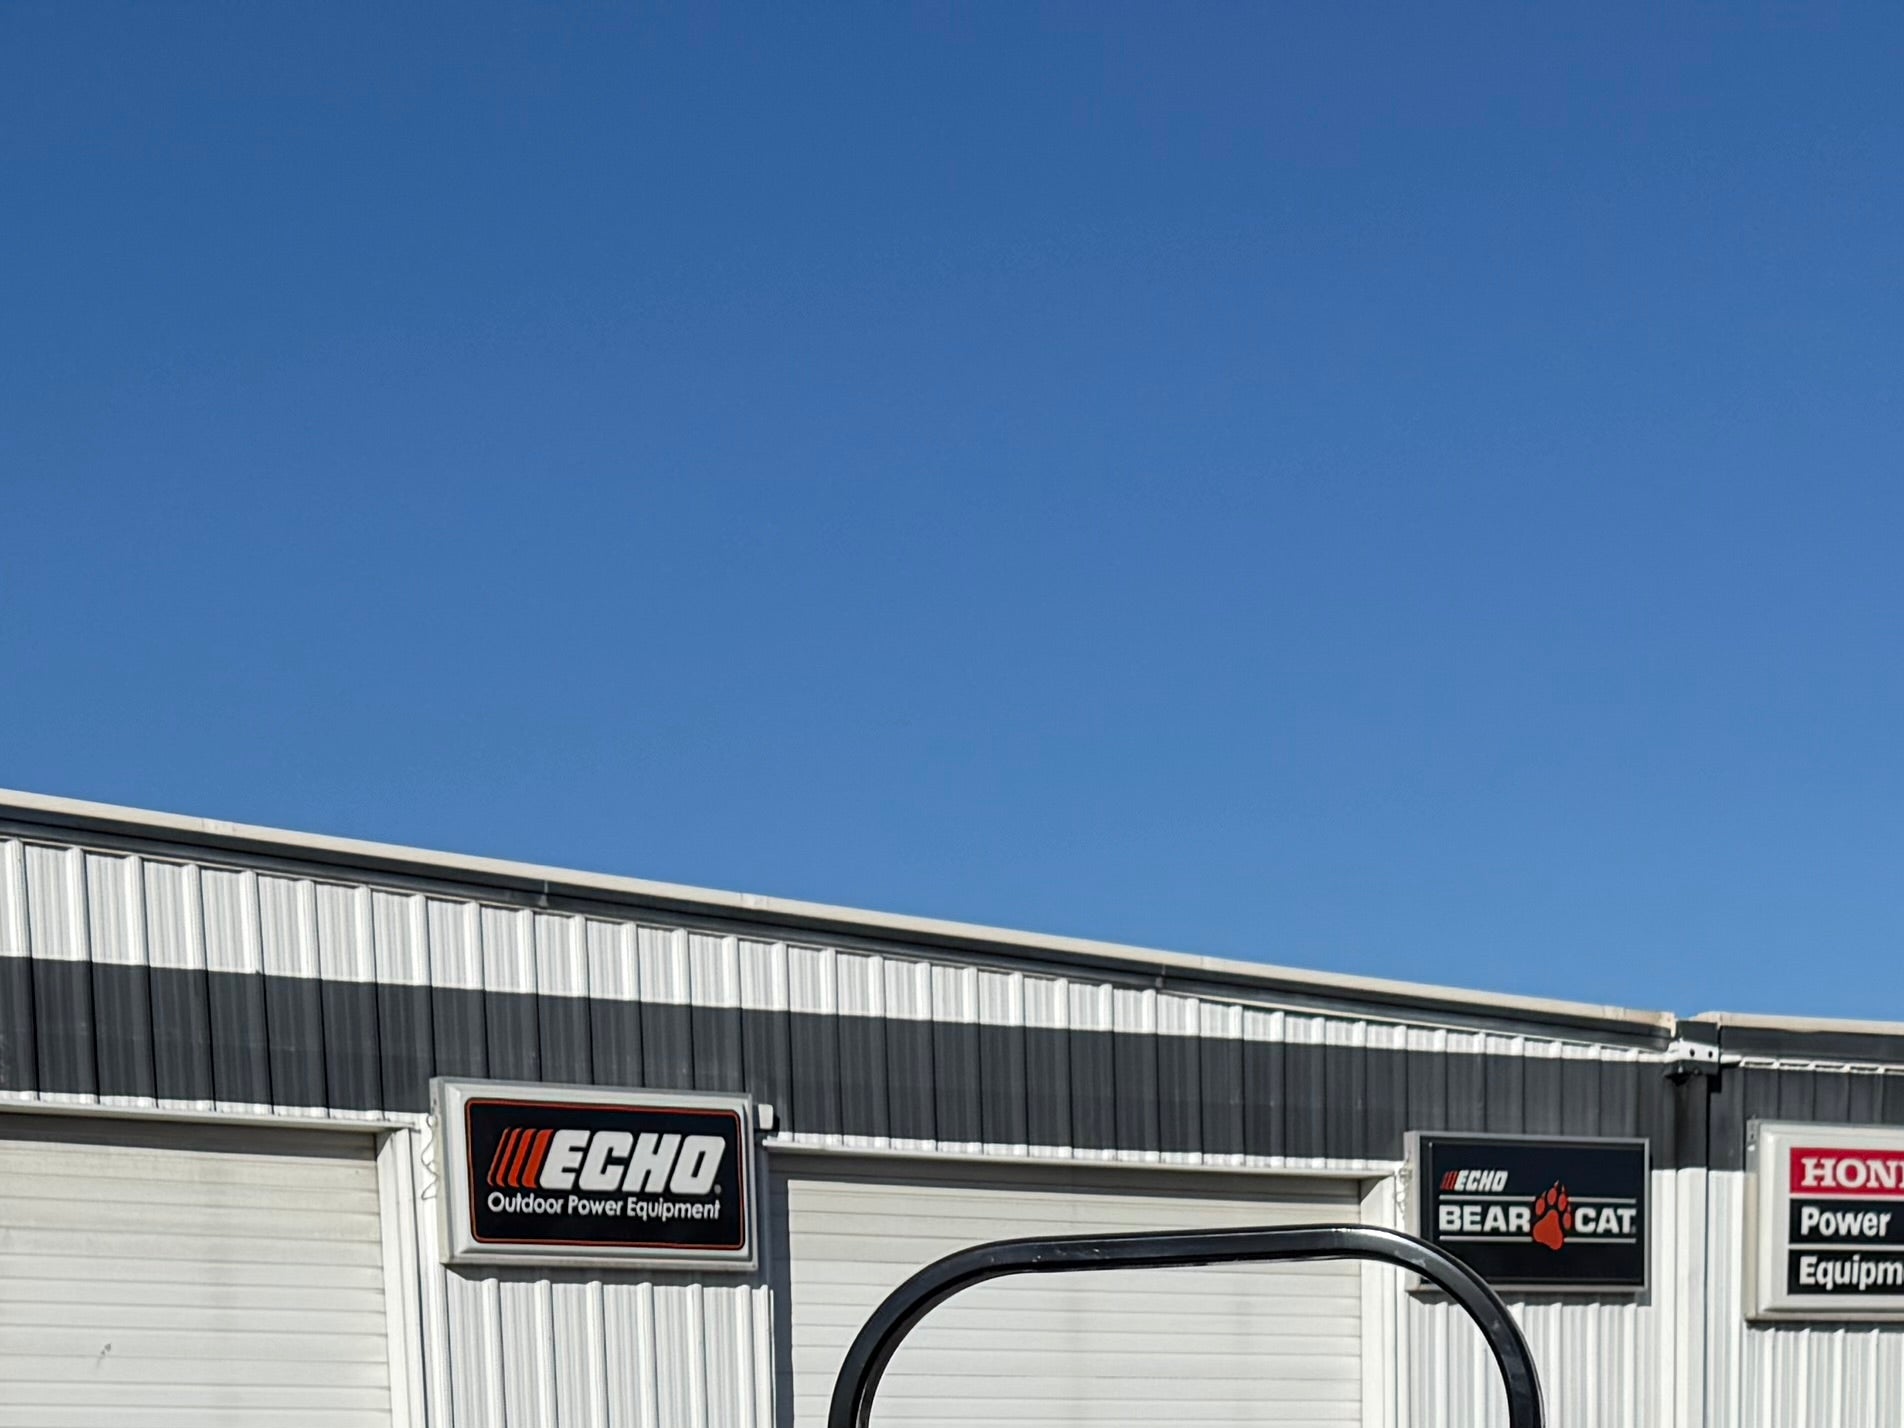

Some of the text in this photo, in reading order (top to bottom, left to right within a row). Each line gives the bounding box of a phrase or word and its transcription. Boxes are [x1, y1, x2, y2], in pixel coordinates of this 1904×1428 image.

[538, 1129, 726, 1195] ECHO
[1454, 1170, 1508, 1191] ECHO
[487, 1191, 721, 1221] Outdoor Power Equipment
[1439, 1205, 1636, 1234] BEAR CAT
[1800, 1206, 1892, 1237] Power
